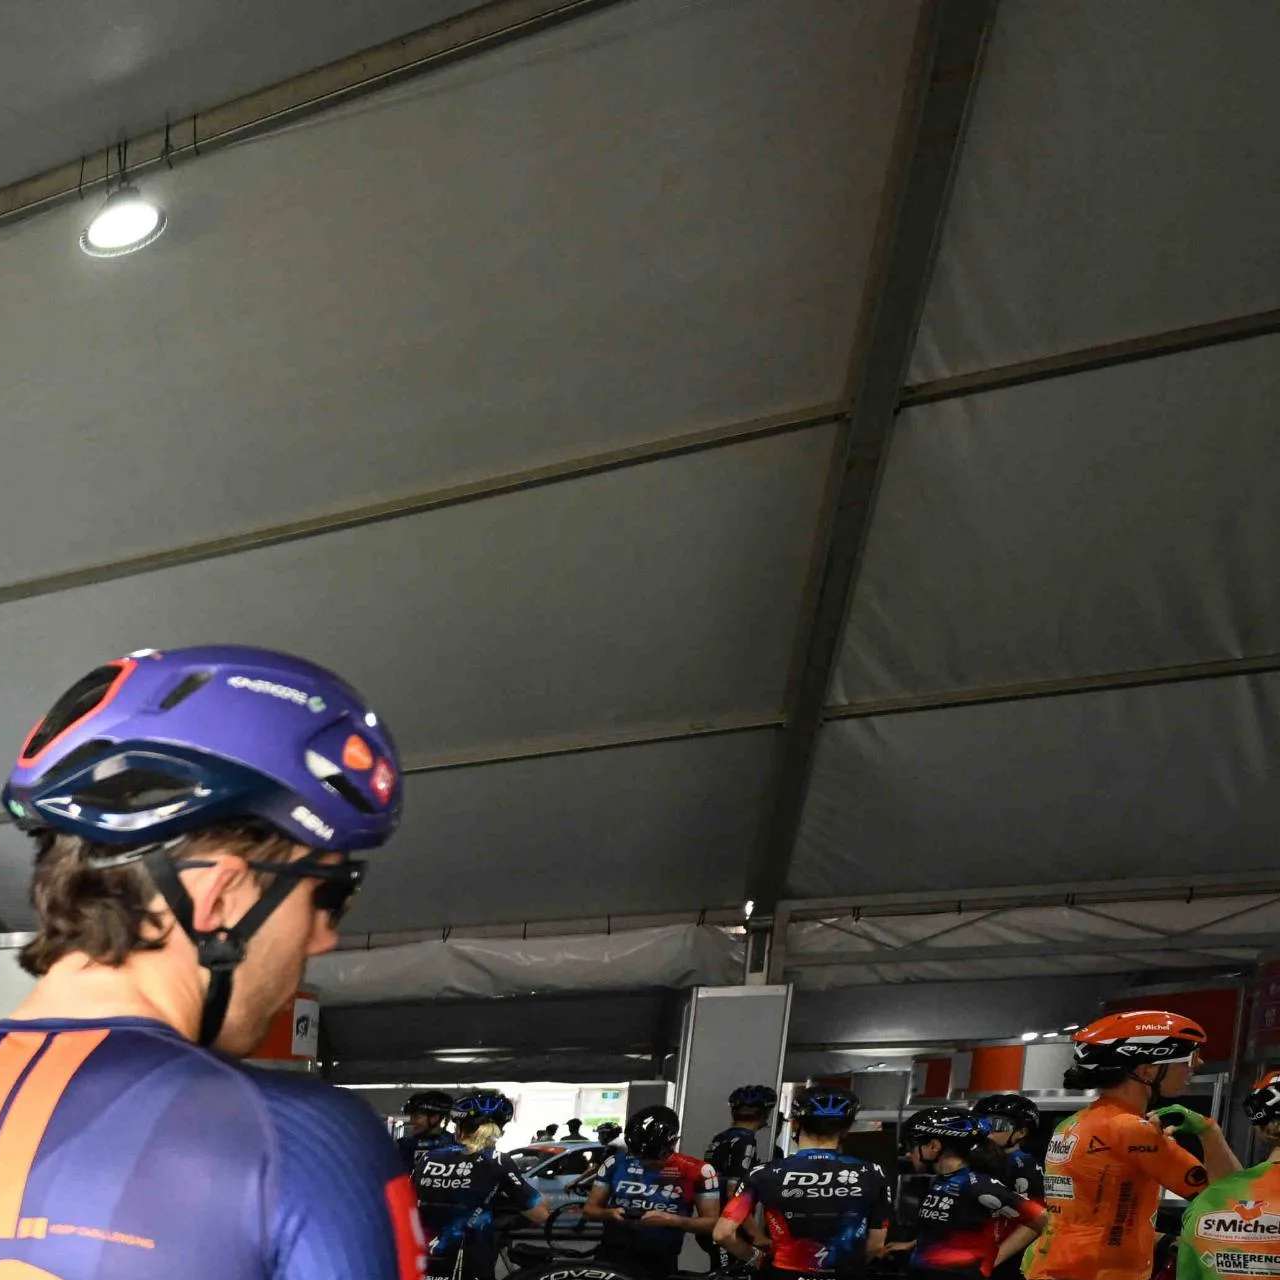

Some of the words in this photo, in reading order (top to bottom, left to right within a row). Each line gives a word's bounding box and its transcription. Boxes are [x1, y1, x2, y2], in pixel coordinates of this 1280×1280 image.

[423, 1161, 456, 1177] FDJ
[783, 1171, 833, 1186] FDJ
[616, 1180, 659, 1197] FDJ
[807, 1187, 863, 1197] suez
[922, 1195, 938, 1208] DJ
[1216, 1260, 1249, 1269] HOME
